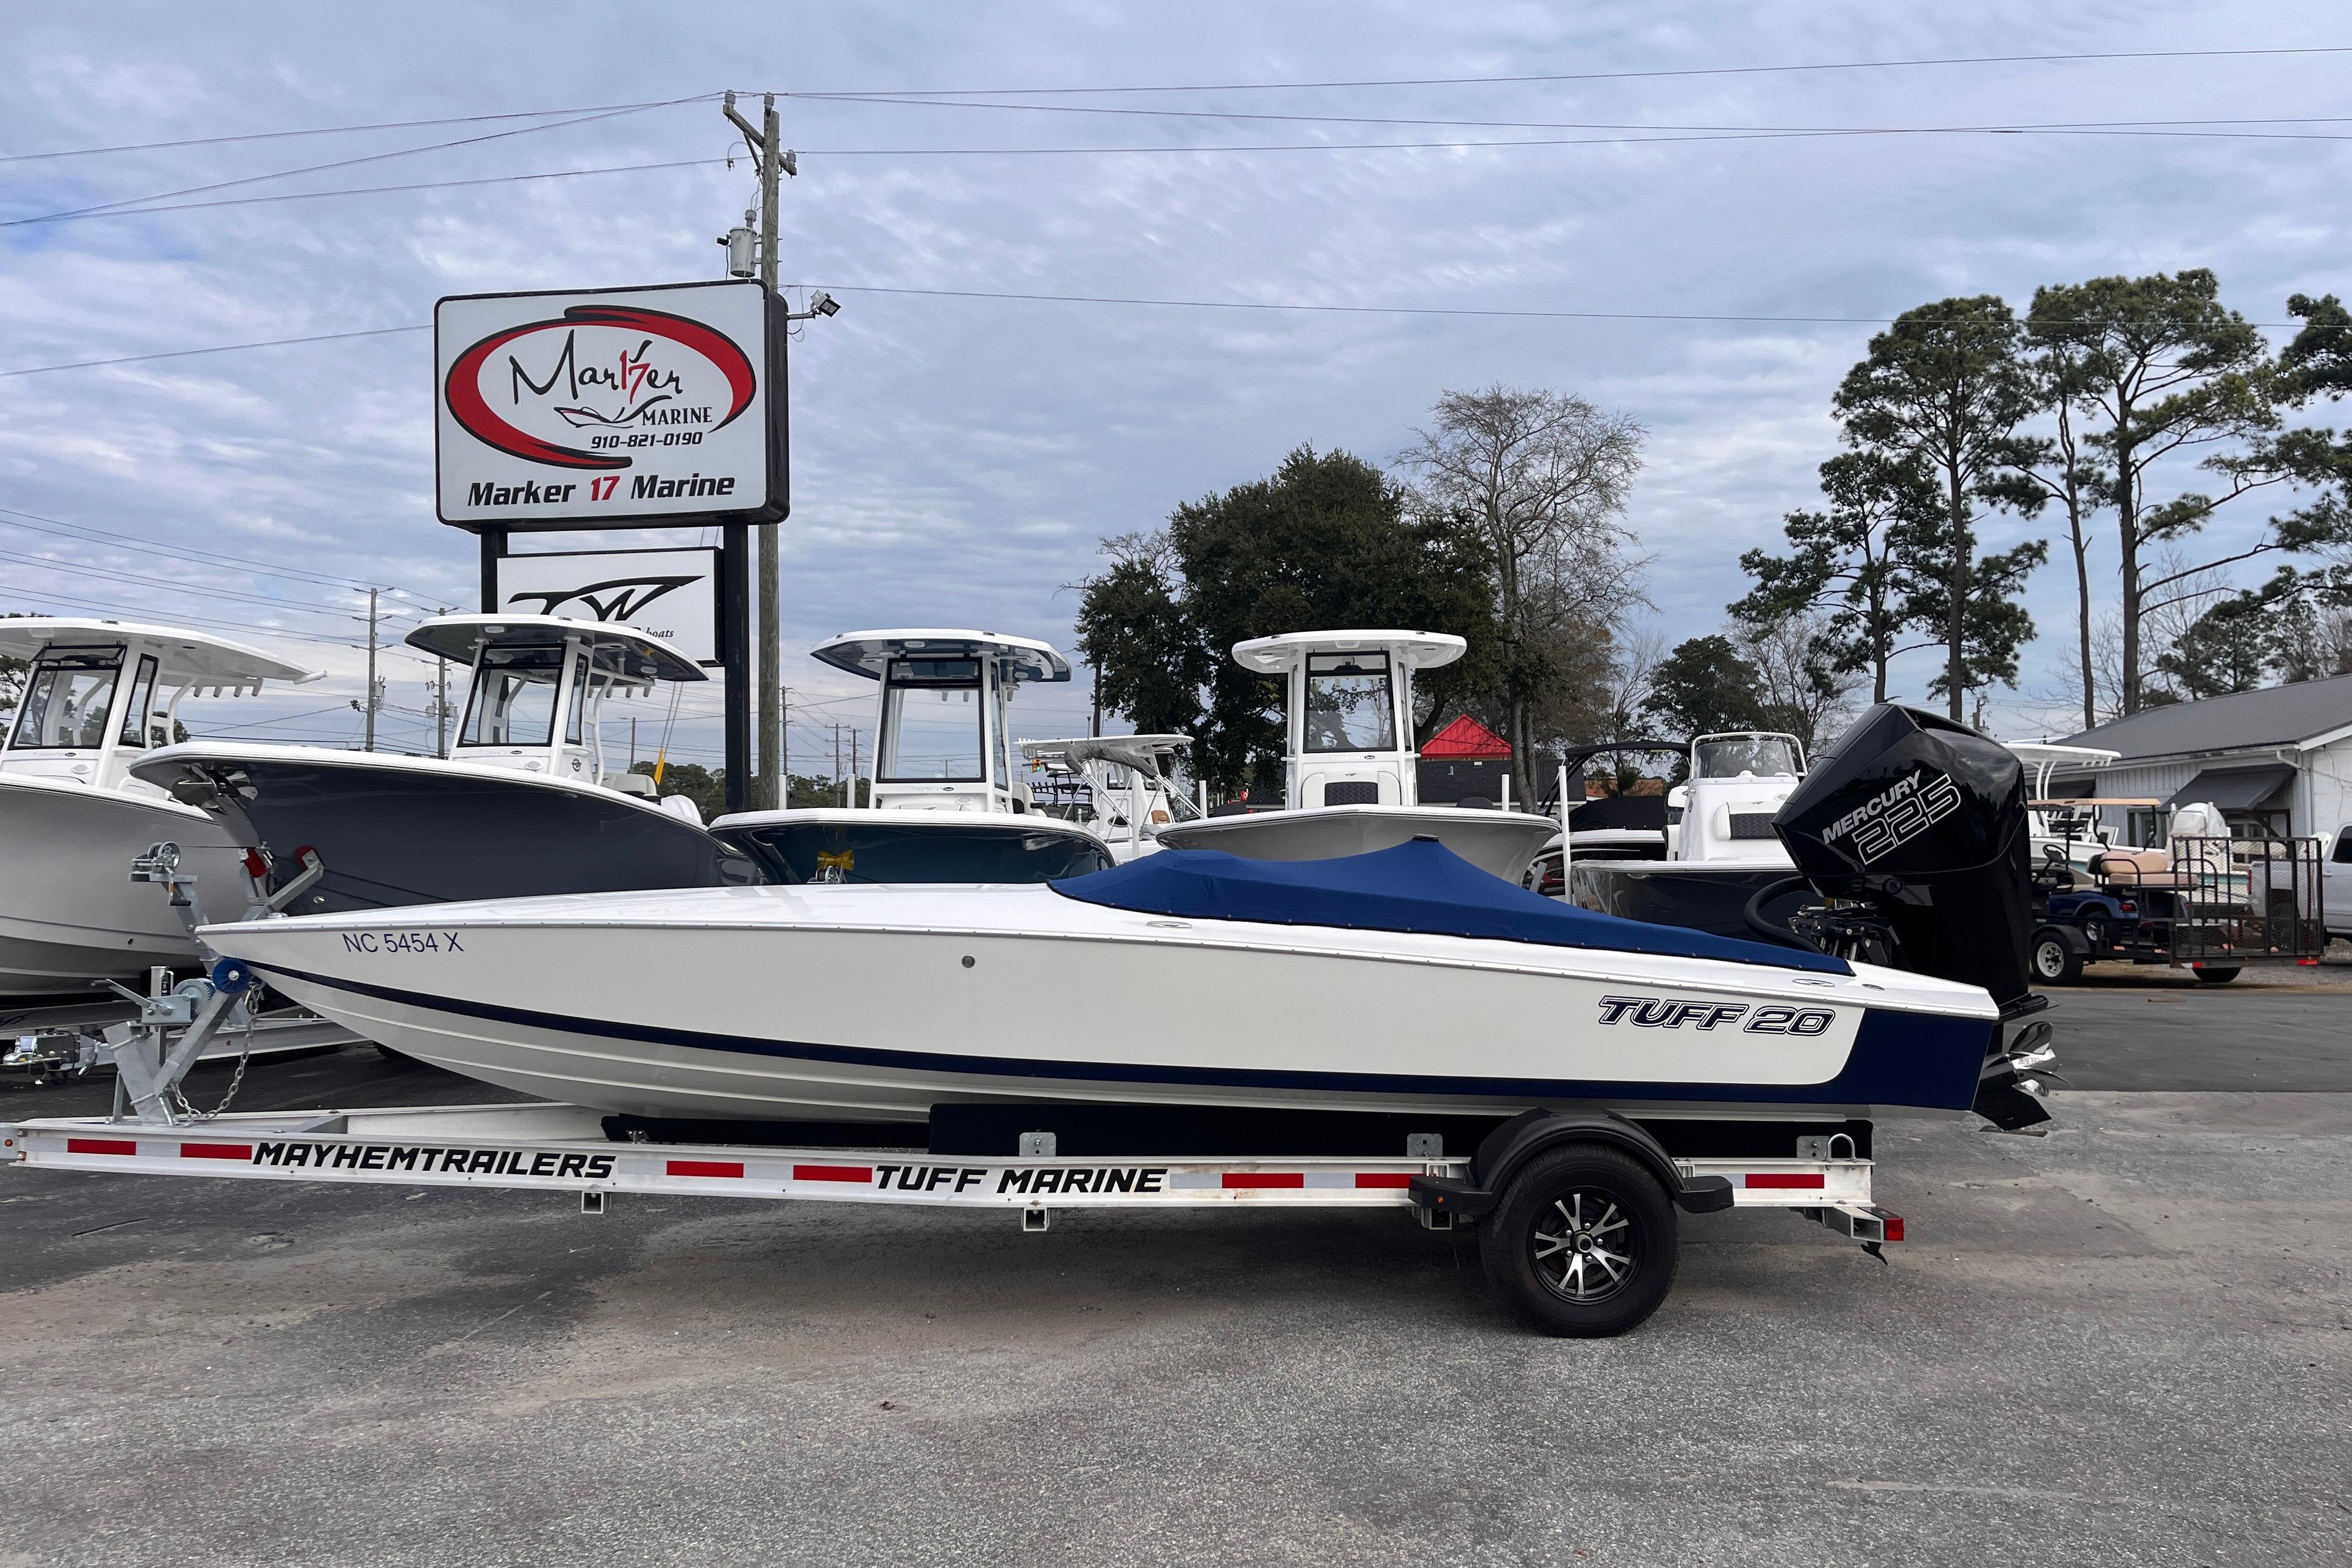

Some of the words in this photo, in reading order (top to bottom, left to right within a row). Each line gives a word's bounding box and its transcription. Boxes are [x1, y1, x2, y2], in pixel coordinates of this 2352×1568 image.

[642, 407, 713, 426] MARINE
[590, 431, 704, 449] 910-821-0190
[467, 480, 576, 506] Marker
[590, 475, 620, 502] 17
[630, 473, 736, 499] Marine
[1822, 769, 1922, 845] MERCURY
[1852, 773, 1961, 865] 225
[342, 933, 379, 953] NC
[383, 933, 439, 953] 5454
[443, 932, 466, 953] X
[1598, 995, 1750, 1030] TUFF
[1742, 1005, 1836, 1037] 20
[252, 1142, 617, 1179] MAYHEMTRAILERS
[875, 1164, 988, 1194] TUFF
[996, 1168, 1169, 1194] MARINE
